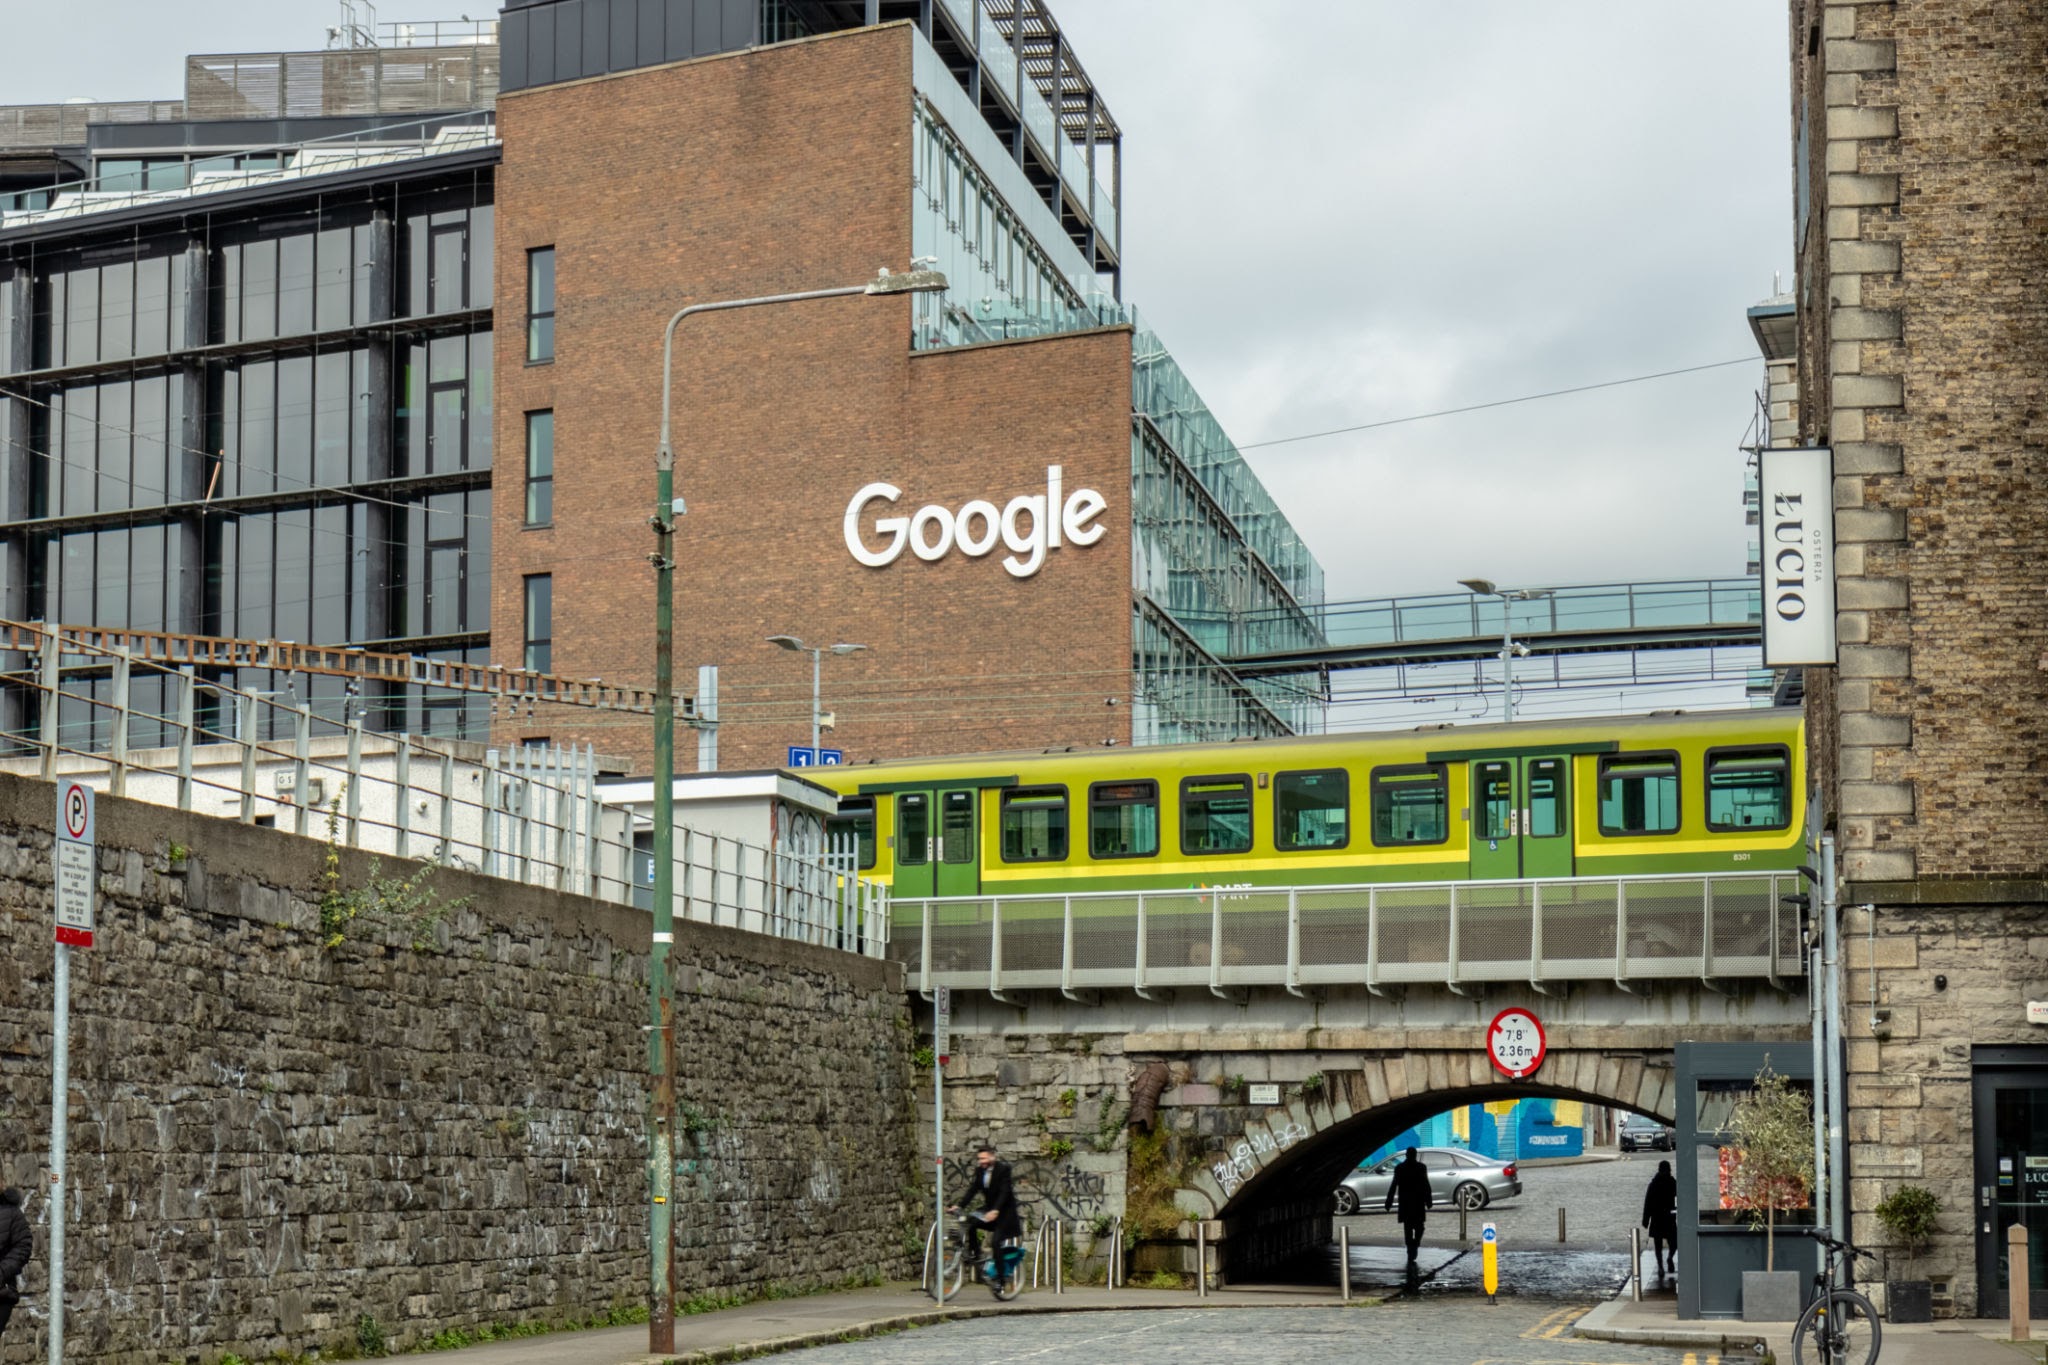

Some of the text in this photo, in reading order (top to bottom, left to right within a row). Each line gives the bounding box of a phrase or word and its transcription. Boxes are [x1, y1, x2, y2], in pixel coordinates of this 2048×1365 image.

[844, 465, 1108, 578] Google
[1813, 529, 1822, 582] OSTERIA
[1499, 1045, 1534, 1057] 2.36m
